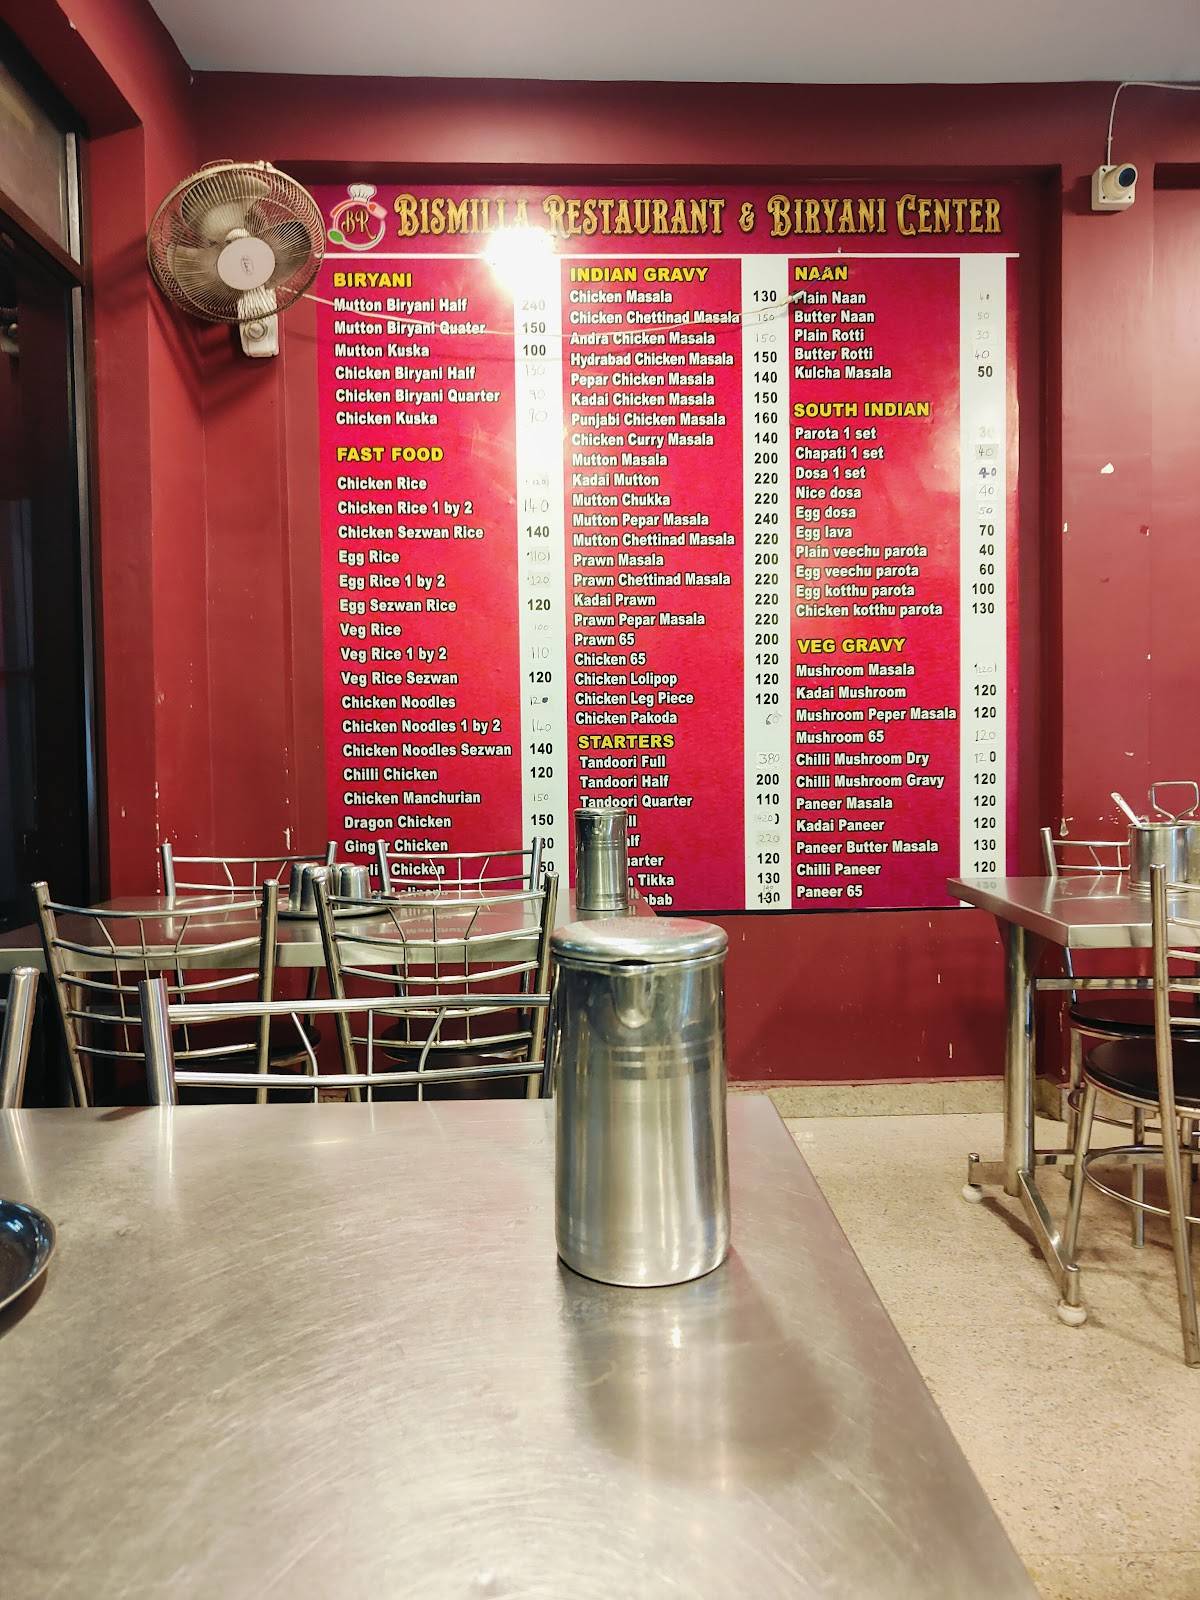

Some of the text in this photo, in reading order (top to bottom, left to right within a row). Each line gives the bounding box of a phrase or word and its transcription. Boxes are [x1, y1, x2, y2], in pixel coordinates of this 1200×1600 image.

[543, 194, 725, 239] RESTAURANT
[738, 201, 755, 232] &
[767, 195, 887, 237] BIRYANI
[896, 193, 1001, 236] CENTER
[334, 272, 412, 287] BIRYANI
[569, 266, 708, 283] INDIAN GRAVY
[795, 266, 848, 280] NAAN
[569, 289, 672, 304] Chicken Masala
[753, 290, 777, 302] 130
[794, 328, 864, 342] Plain Rotti
[335, 343, 430, 357] Mutton Kuska
[523, 344, 546, 356] 100
[754, 351, 778, 363] 150
[570, 352, 734, 369] Hydrabad Chicken Masala
[795, 366, 892, 379] Kulcha Masala
[977, 365, 993, 378] 50
[336, 388, 501, 405] Chicken Biryani Quarter
[794, 402, 929, 417] SOUTH INDIAN
[336, 411, 438, 425] Chicken Kuska
[570, 412, 726, 430] Punjabi Chicken Masala
[754, 412, 778, 424] 160
[754, 432, 778, 444] 140
[795, 426, 876, 440] Parota 1 set
[571, 432, 714, 449] Chicken Curry Masala
[337, 447, 443, 462] FAST FOOD
[754, 472, 778, 485] 220
[796, 466, 866, 479] Dosa 1 set
[337, 476, 427, 490] Chicken Rice
[571, 473, 659, 487] Kadai Mutton
[571, 492, 670, 506] Mutton Chukka
[754, 492, 778, 505] 220
[338, 525, 484, 539] Chicken Sezwan Rice
[526, 526, 549, 538] 140
[796, 526, 852, 541] Egg lava
[979, 524, 994, 536] 70
[796, 545, 927, 560] Plain veechu parota
[979, 544, 994, 556] 40
[339, 574, 445, 590] Egg Rice 1 by 2
[340, 598, 456, 614] Egg Sezwan Rice
[527, 599, 551, 611] 120
[795, 602, 942, 618] Chicken kotthu parota
[972, 602, 995, 614] 130
[574, 633, 634, 646] Prawn 65
[755, 633, 779, 646] 200
[797, 638, 906, 653] VEG GRAVY
[341, 671, 458, 688] Veg Rice Sezwan
[528, 671, 552, 683] 120
[575, 672, 677, 687] Chicken Lolipop
[755, 673, 779, 685] 120
[796, 686, 906, 699] Kadai Mushroom
[974, 684, 997, 696] 120
[342, 696, 456, 708] Chicken Noodles
[575, 692, 694, 707] Chicken Leg Piece
[755, 692, 779, 705] 120
[576, 711, 677, 724] Chicken Pakoda
[796, 707, 956, 723] Mushroom Peper Masala
[974, 706, 997, 718] 120
[578, 734, 674, 749] STARTERS
[796, 730, 884, 744] Mushroom 65
[343, 743, 512, 757] Chicken Noodles Sezwan
[529, 742, 553, 755] 140
[579, 755, 666, 768] Tandoori Full
[344, 768, 437, 781] Chilli Chicken
[530, 766, 553, 779] 120
[756, 773, 780, 786] 200
[974, 772, 996, 785] 120
[580, 774, 669, 788] Tandoori Half
[796, 774, 944, 788] Chilli Mushroom Gravy
[344, 791, 480, 805] Chicken Manchurian
[580, 795, 692, 809] Tandoori Quarter
[756, 793, 780, 805] 110
[796, 796, 893, 810] Paneer Masala
[974, 795, 996, 807] 120
[344, 815, 451, 832] Dragon Chicken
[530, 813, 554, 826] 150
[344, 839, 449, 855] Gingr Chicken
[796, 840, 938, 854] Paneer Butter Masala
[974, 839, 996, 851] 130
[796, 863, 881, 876] Chilli Paneer
[974, 860, 996, 873] 120
[797, 884, 862, 898] Paneer 65
